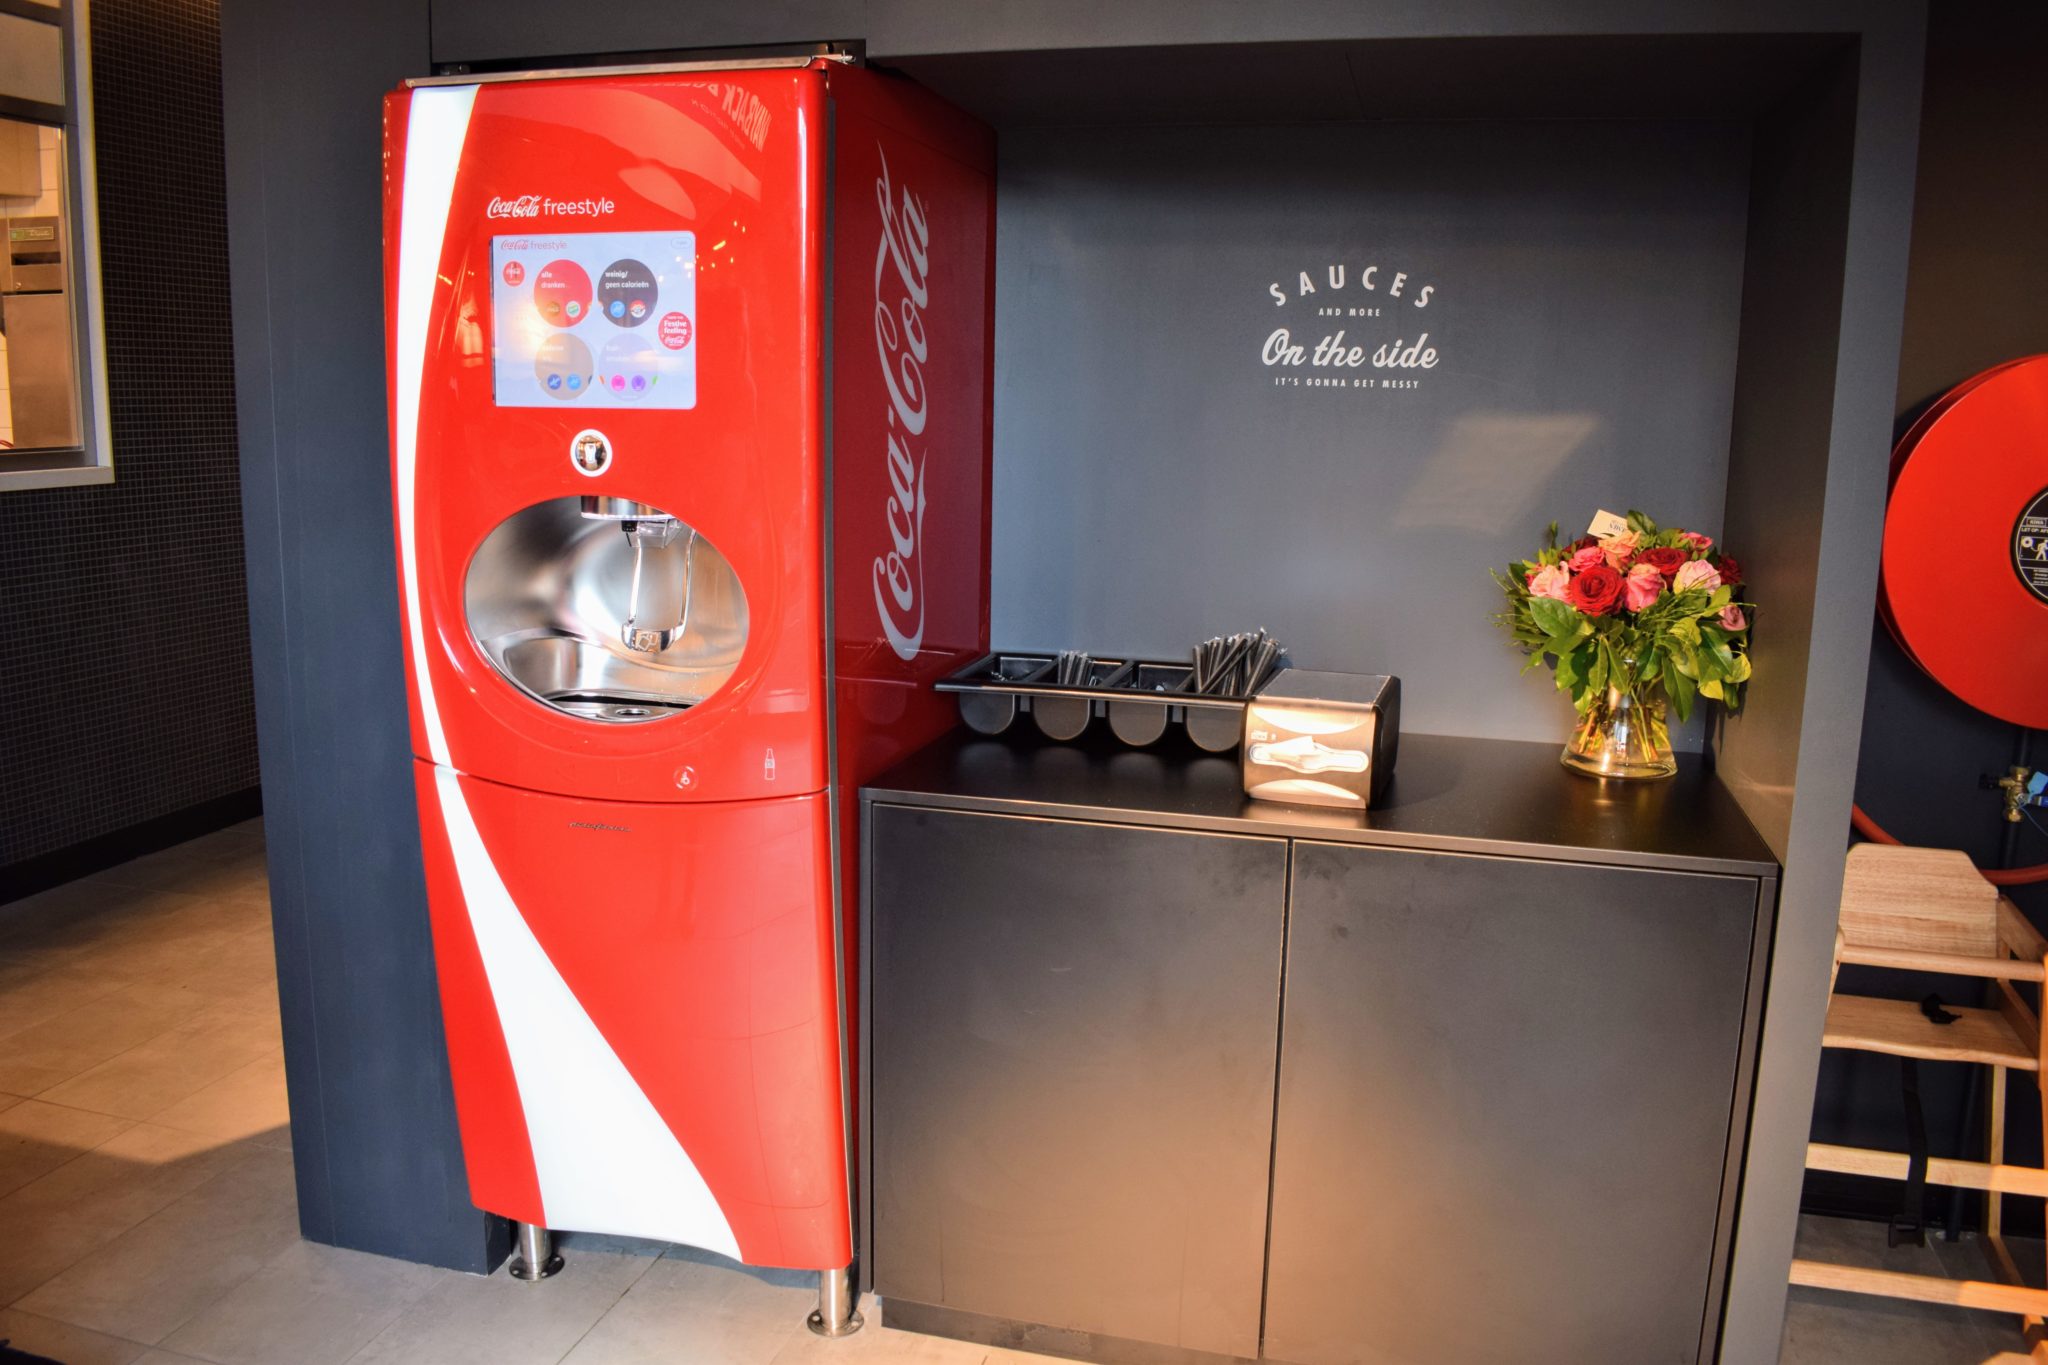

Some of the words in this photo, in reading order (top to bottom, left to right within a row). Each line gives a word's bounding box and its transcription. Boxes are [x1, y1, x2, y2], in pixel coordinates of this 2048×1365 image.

[487, 195, 542, 218] Coca-Cola
[543, 197, 615, 217] freestyle
[530, 239, 567, 251] freestyle
[605, 281, 620, 289] geen
[1269, 264, 1435, 308] SAUCES
[1318, 308, 1341, 317] AND
[1349, 308, 1380, 317] MORE
[663, 319, 687, 328] Festive
[663, 327, 687, 336] feeling
[1262, 328, 1306, 366] On
[1312, 330, 1365, 367] the
[1372, 333, 1439, 369] side
[1275, 377, 1298, 386] IT'S
[1306, 378, 1346, 387] GONNA
[1354, 379, 1374, 388] GET
[1382, 380, 1419, 389] MESSY
[873, 139, 929, 661] Coca-Cola
